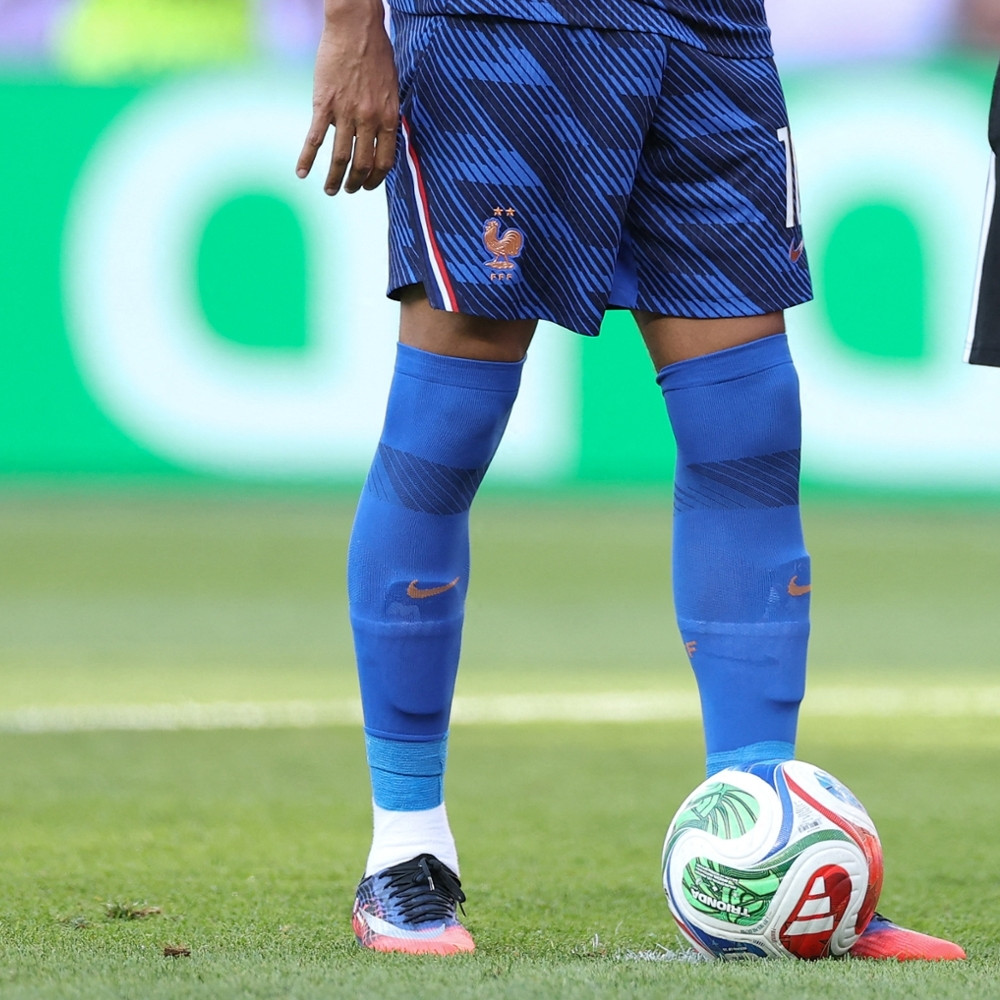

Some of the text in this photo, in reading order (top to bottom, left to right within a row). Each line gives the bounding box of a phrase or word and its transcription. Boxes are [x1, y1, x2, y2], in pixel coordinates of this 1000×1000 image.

[776, 126, 802, 229] 1
[490, 273, 513, 281] FFF
[690, 886, 751, 918] TRIONDA
